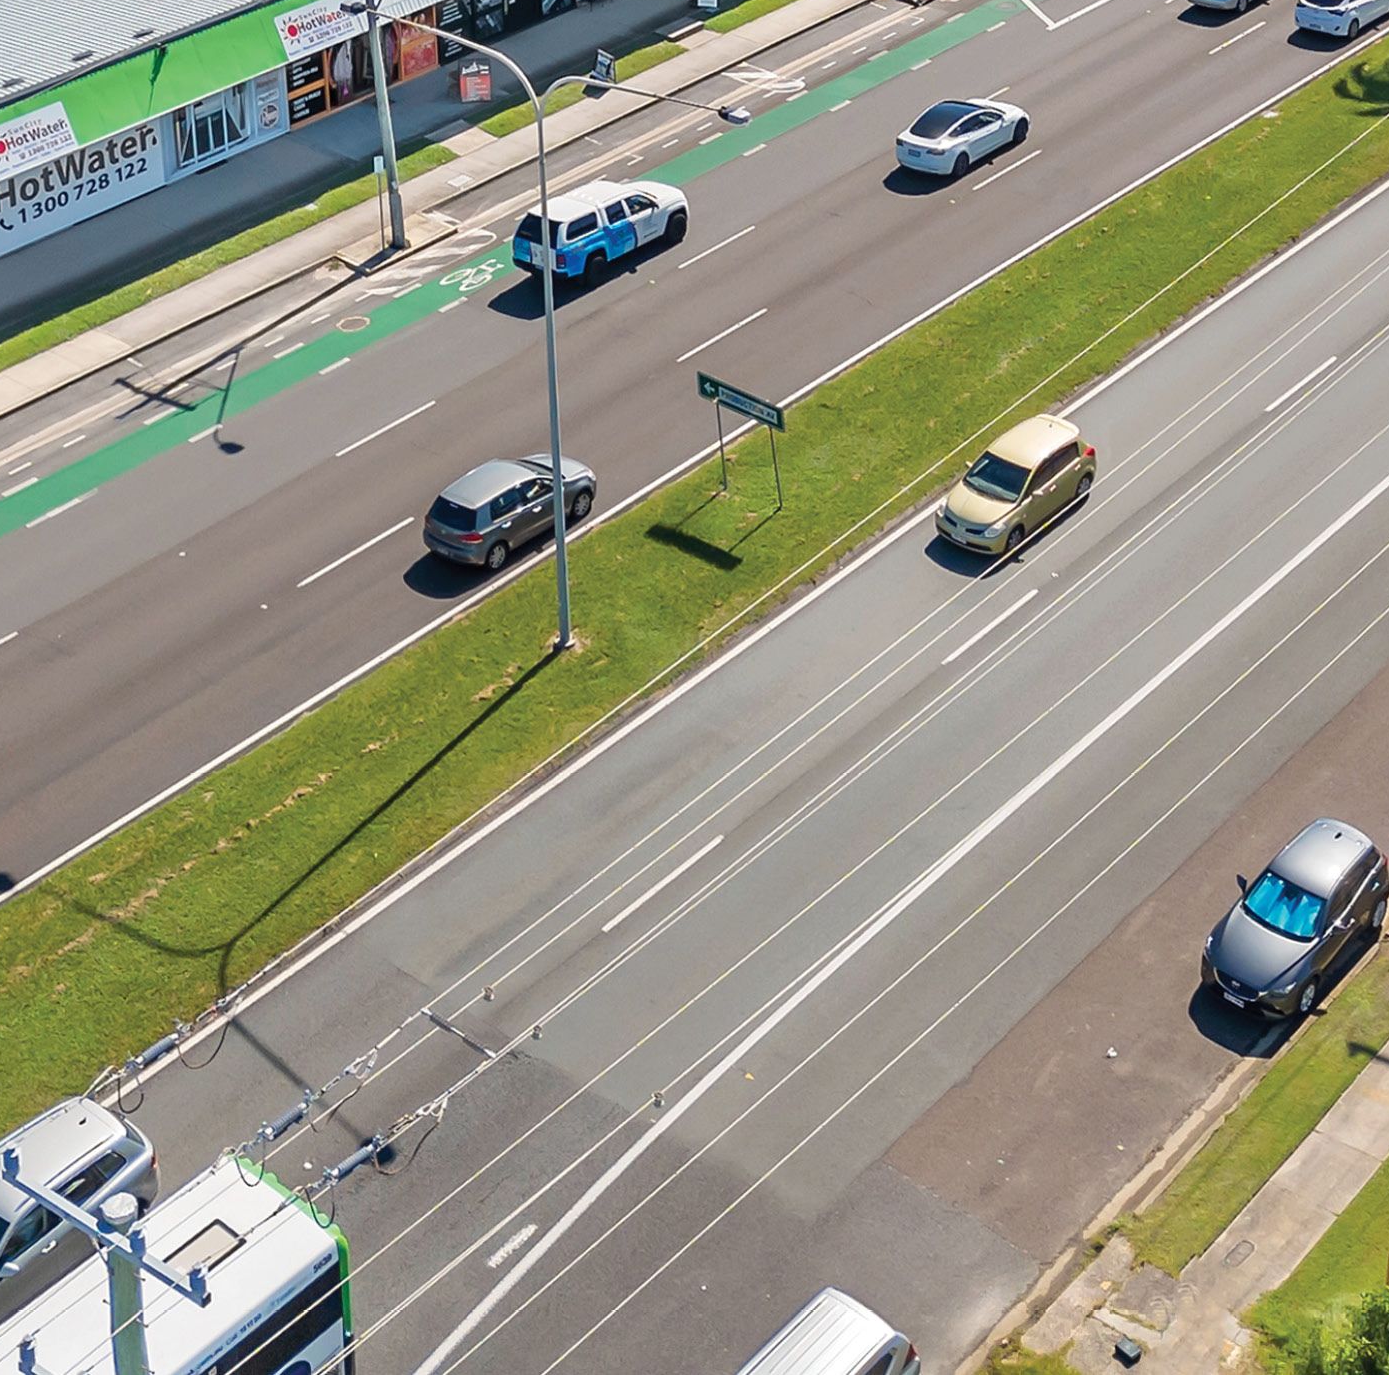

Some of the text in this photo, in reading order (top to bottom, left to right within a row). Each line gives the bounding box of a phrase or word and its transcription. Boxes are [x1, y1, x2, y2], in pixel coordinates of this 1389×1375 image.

[4, 118, 68, 150] HotWater
[18, 157, 148, 223] 1300 728 122
